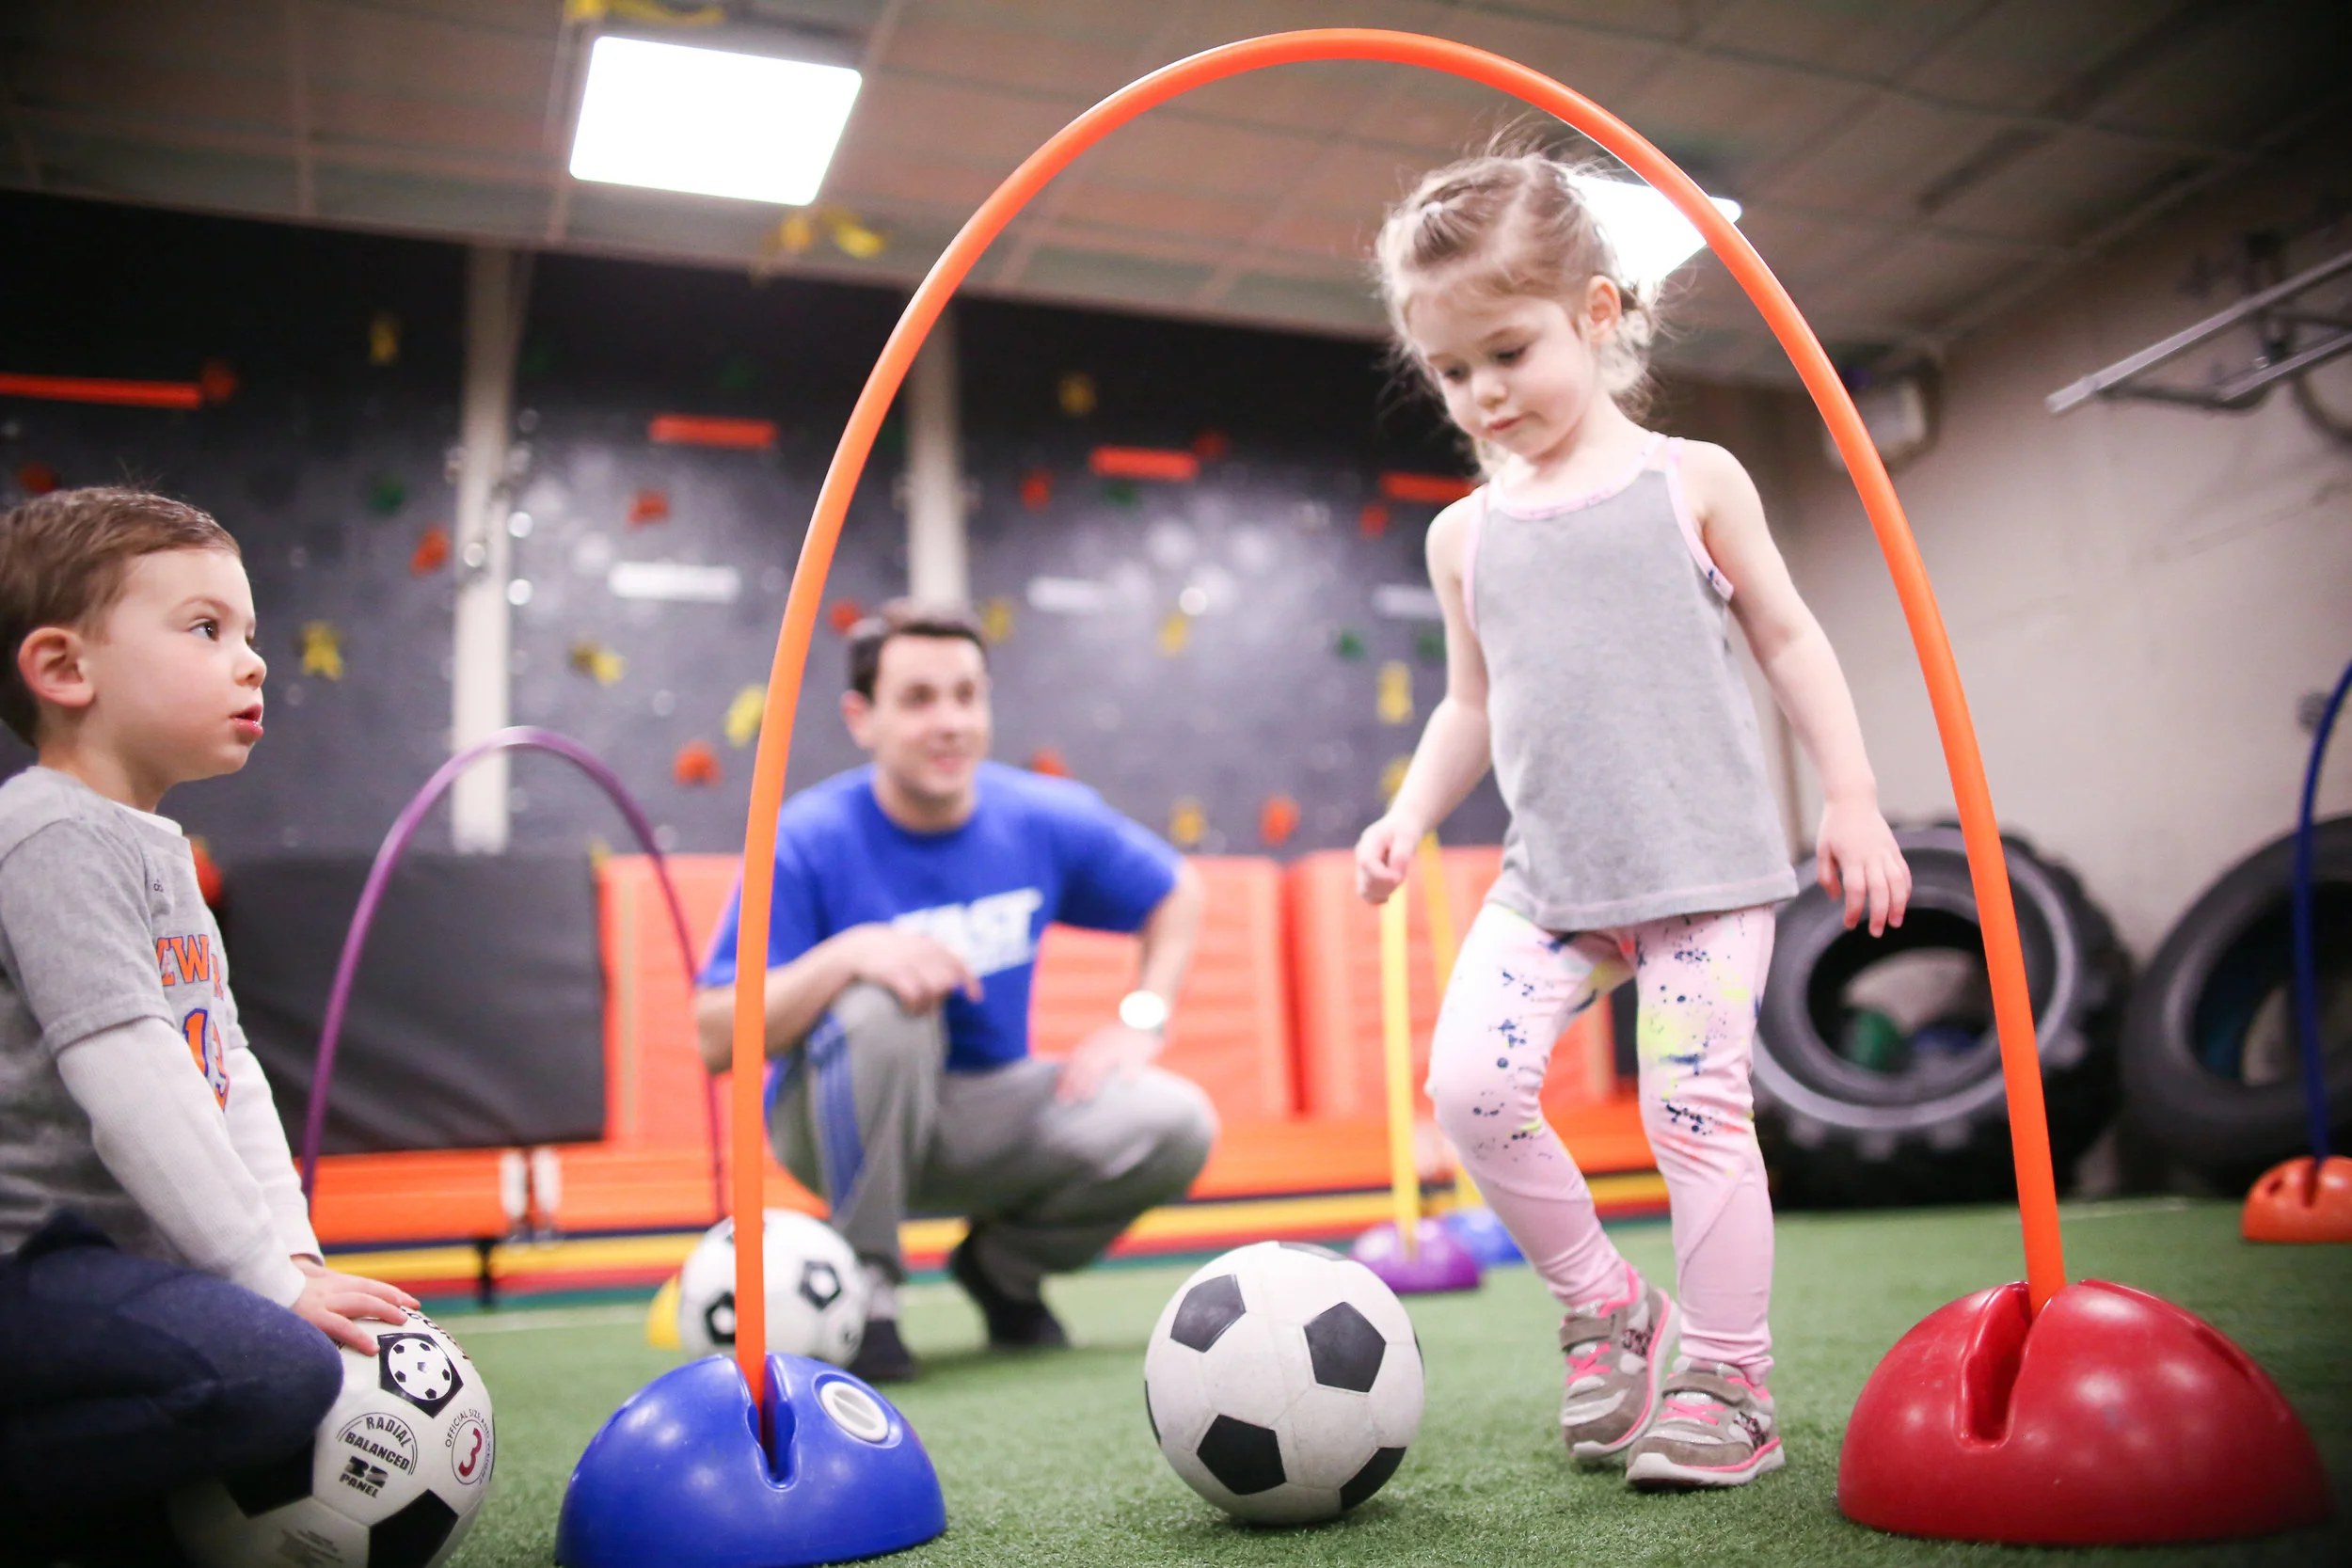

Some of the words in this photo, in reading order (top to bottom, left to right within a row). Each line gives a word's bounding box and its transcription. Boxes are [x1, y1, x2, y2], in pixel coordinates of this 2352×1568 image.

[366, 1417, 412, 1449] RADIAL
[445, 1410, 469, 1448] OFFICIAL
[469, 1408, 481, 1420] SIZE
[344, 1431, 410, 1471] BALANCED
[458, 1427, 483, 1477] 3
[339, 1472, 379, 1499] PANEL
[344, 1455, 389, 1489] 32
